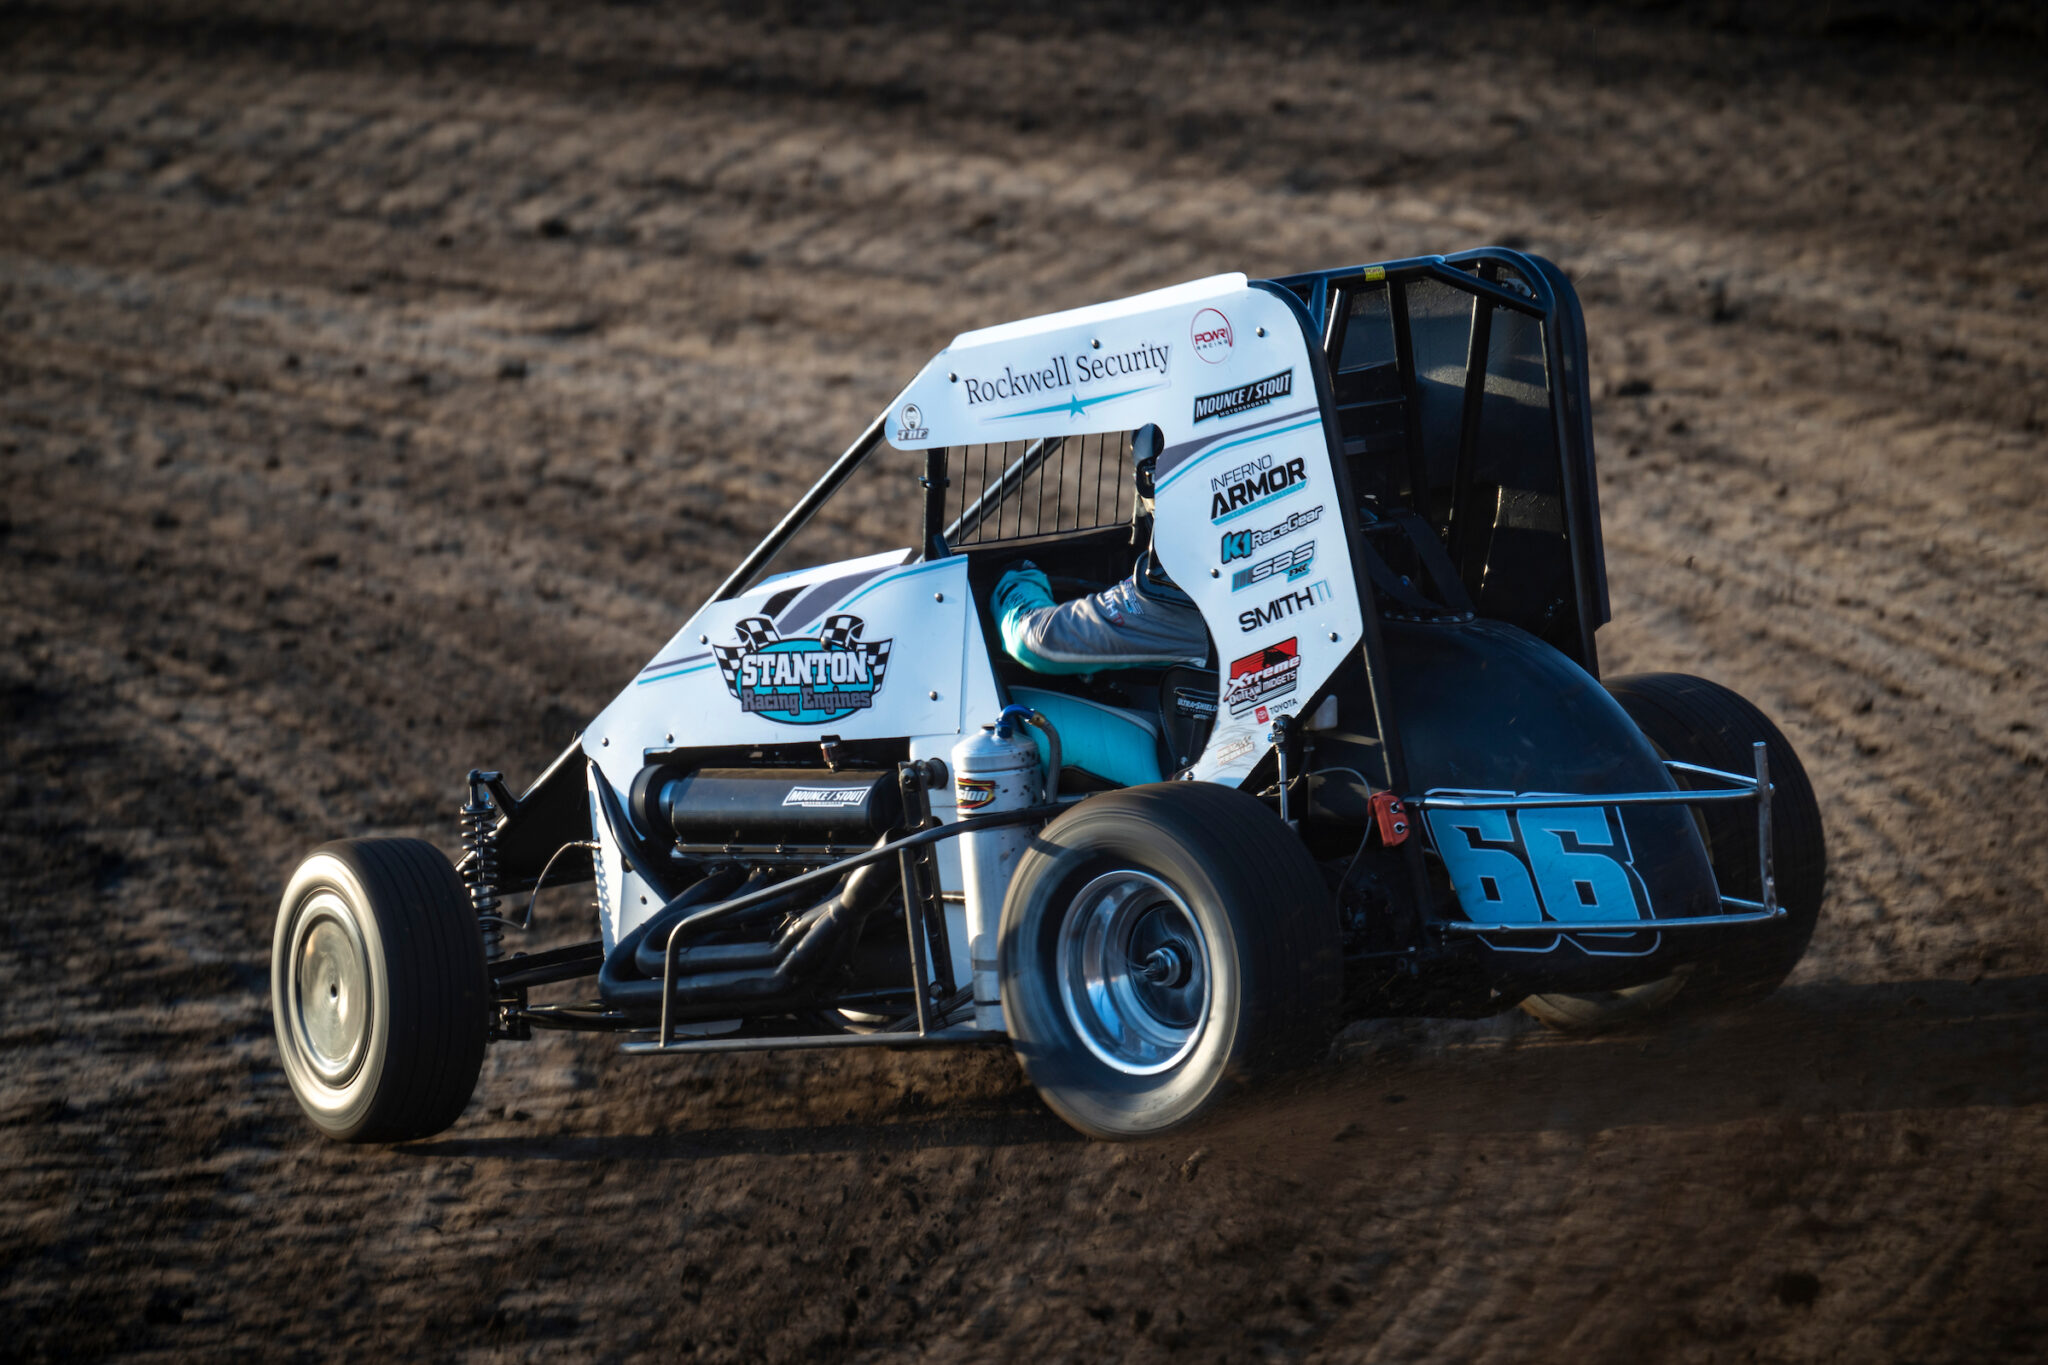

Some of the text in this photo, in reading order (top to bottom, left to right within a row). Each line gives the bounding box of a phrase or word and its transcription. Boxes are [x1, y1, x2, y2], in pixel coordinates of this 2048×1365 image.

[964, 343, 1169, 405] Rockwell Security
[1196, 387, 1246, 418] MOUNCE
[1255, 374, 1291, 399] STOUT
[1219, 399, 1268, 417] MOTORSPORTS
[1210, 454, 1273, 492] INFERNO
[1210, 457, 1308, 520] ARMOR
[1251, 540, 1315, 583] SBS
[741, 650, 871, 687] STANTON
[1262, 671, 1297, 692] MIDGETS
[742, 686, 872, 716] Racing Engines
[1269, 698, 1298, 715] TOYOTA
[787, 790, 828, 802] MOUNCE
[834, 790, 865, 802] STOUT
[1424, 795, 1652, 948] 66
